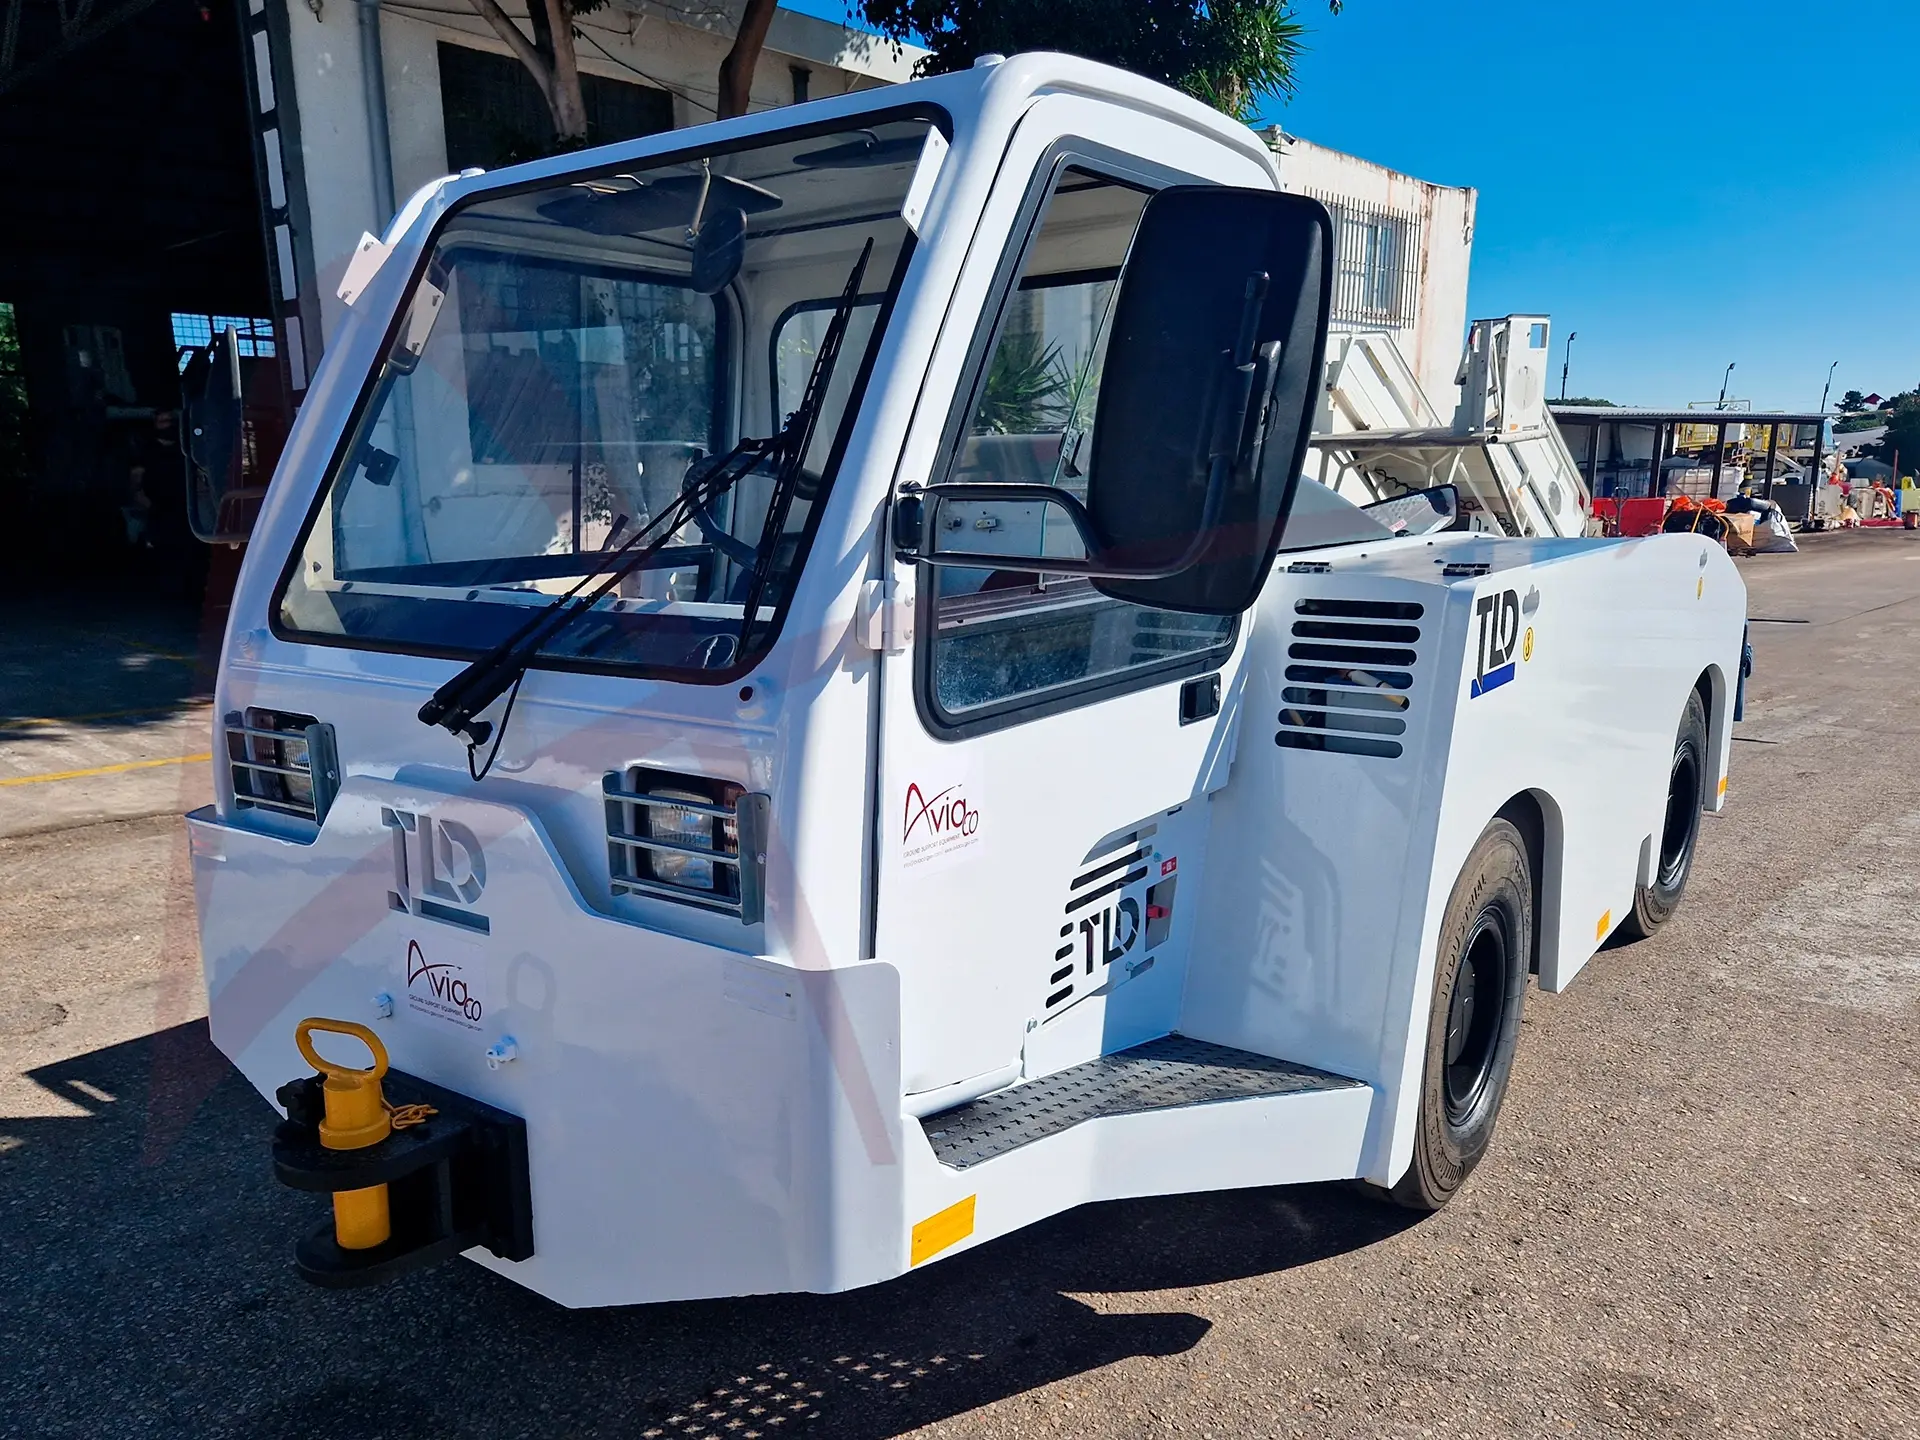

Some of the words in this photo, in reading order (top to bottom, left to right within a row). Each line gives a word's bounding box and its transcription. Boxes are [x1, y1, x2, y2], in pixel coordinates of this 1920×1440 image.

[1476, 588, 1520, 689] TLD
[380, 806, 487, 914] TLD
[1079, 897, 1140, 977] TLD
